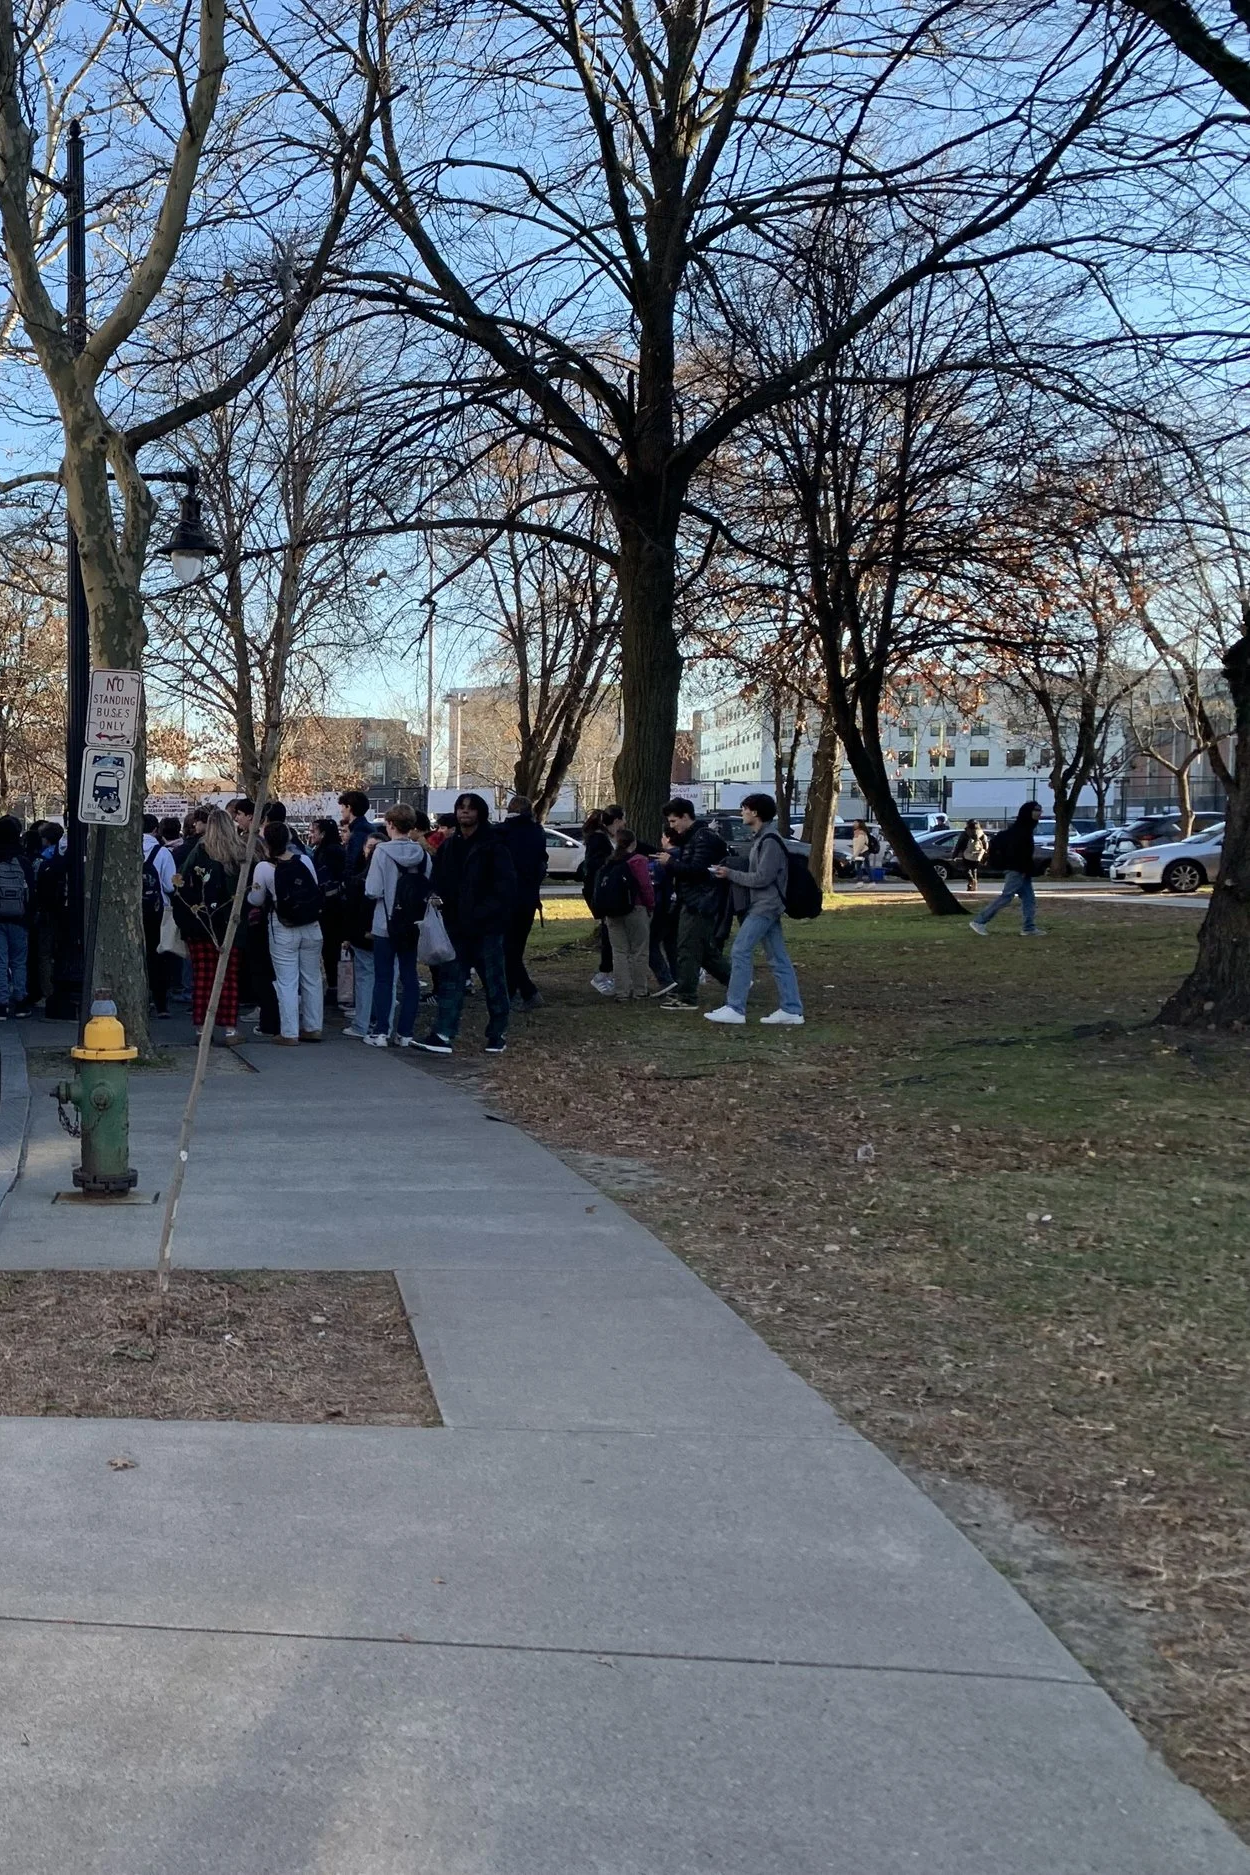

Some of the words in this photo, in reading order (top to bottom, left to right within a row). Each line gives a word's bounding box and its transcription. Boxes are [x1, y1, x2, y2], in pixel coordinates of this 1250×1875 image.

[106, 678, 125, 692] NO
[93, 694, 136, 706] STANDING
[96, 707, 130, 718] BUSES
[99, 720, 125, 731] ONLY
